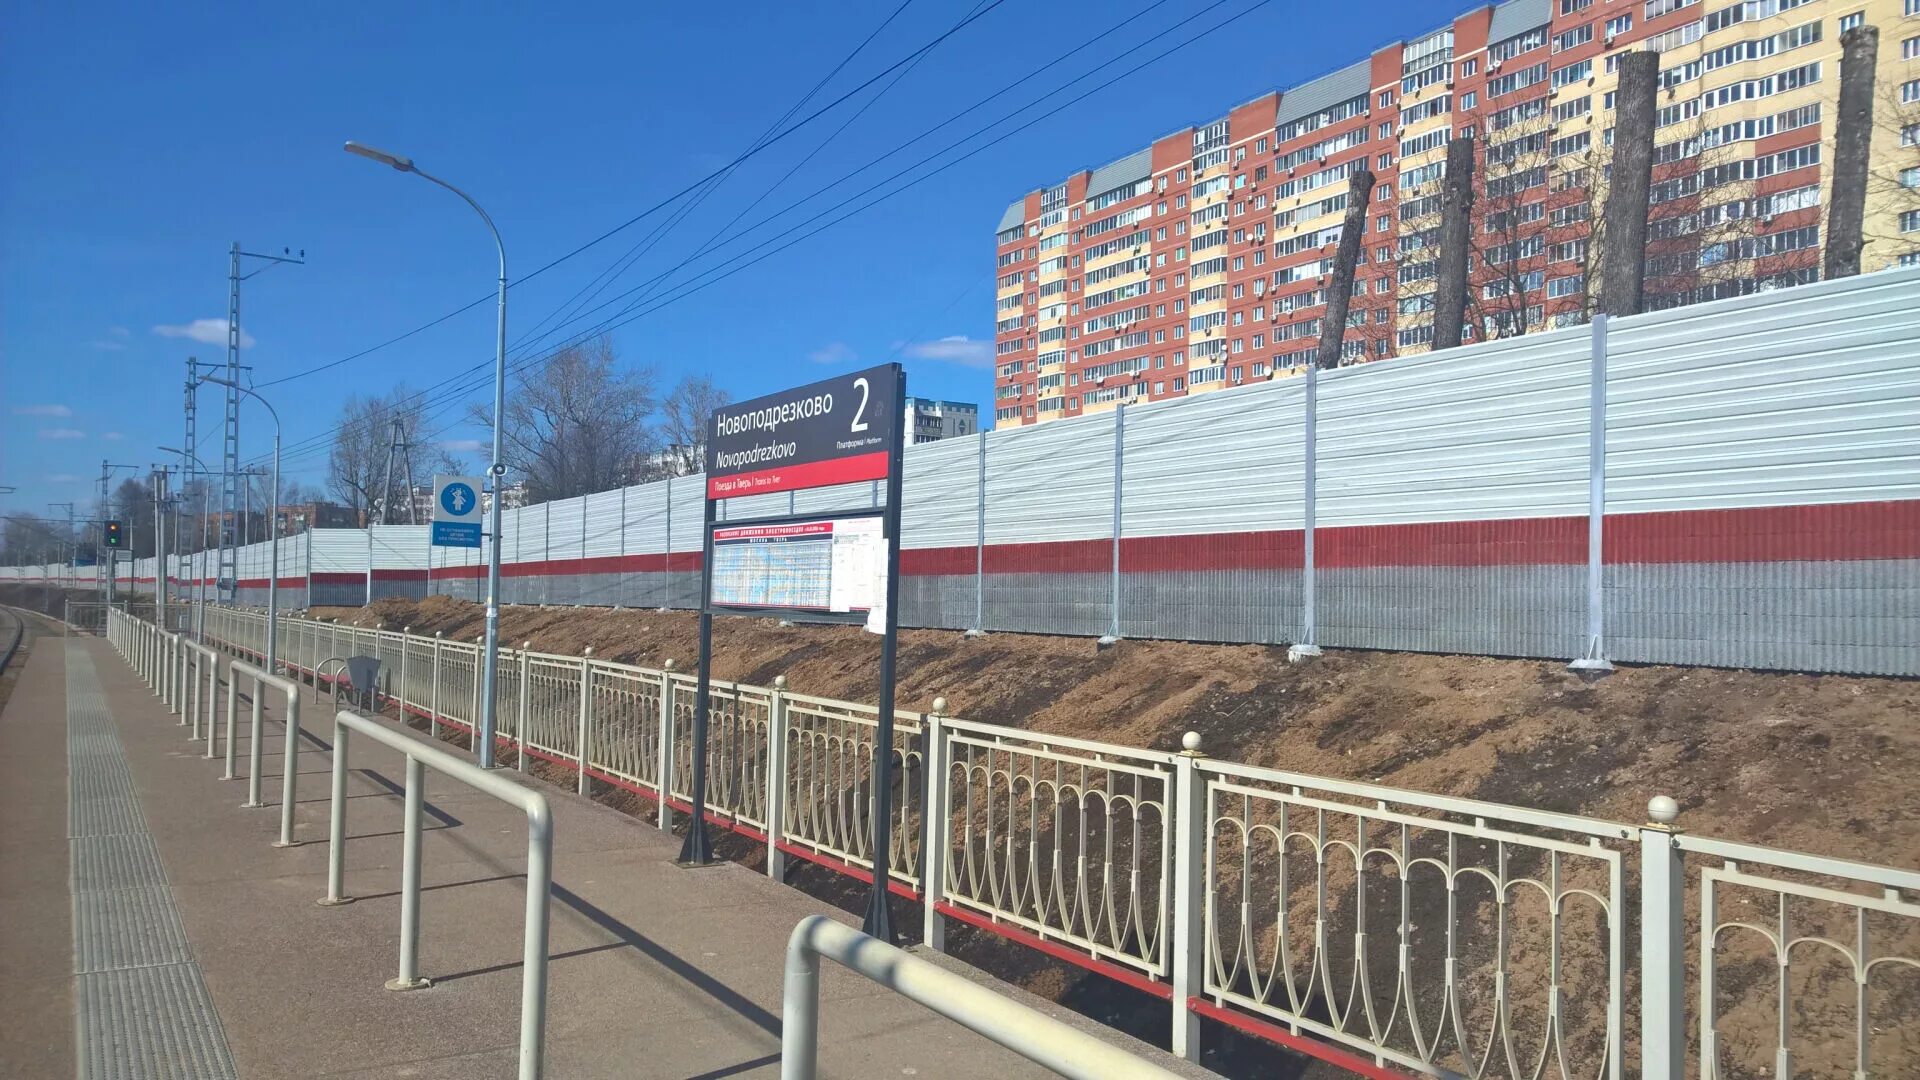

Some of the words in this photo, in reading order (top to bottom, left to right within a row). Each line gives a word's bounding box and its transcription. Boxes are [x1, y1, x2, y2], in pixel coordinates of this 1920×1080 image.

[717, 393, 833, 437] Новоподрезково
[851, 377, 869, 433] 2
[716, 439, 796, 470] Novopodrezkovo
[715, 481, 732, 491] Поезда
[737, 478, 751, 490] Тверь
